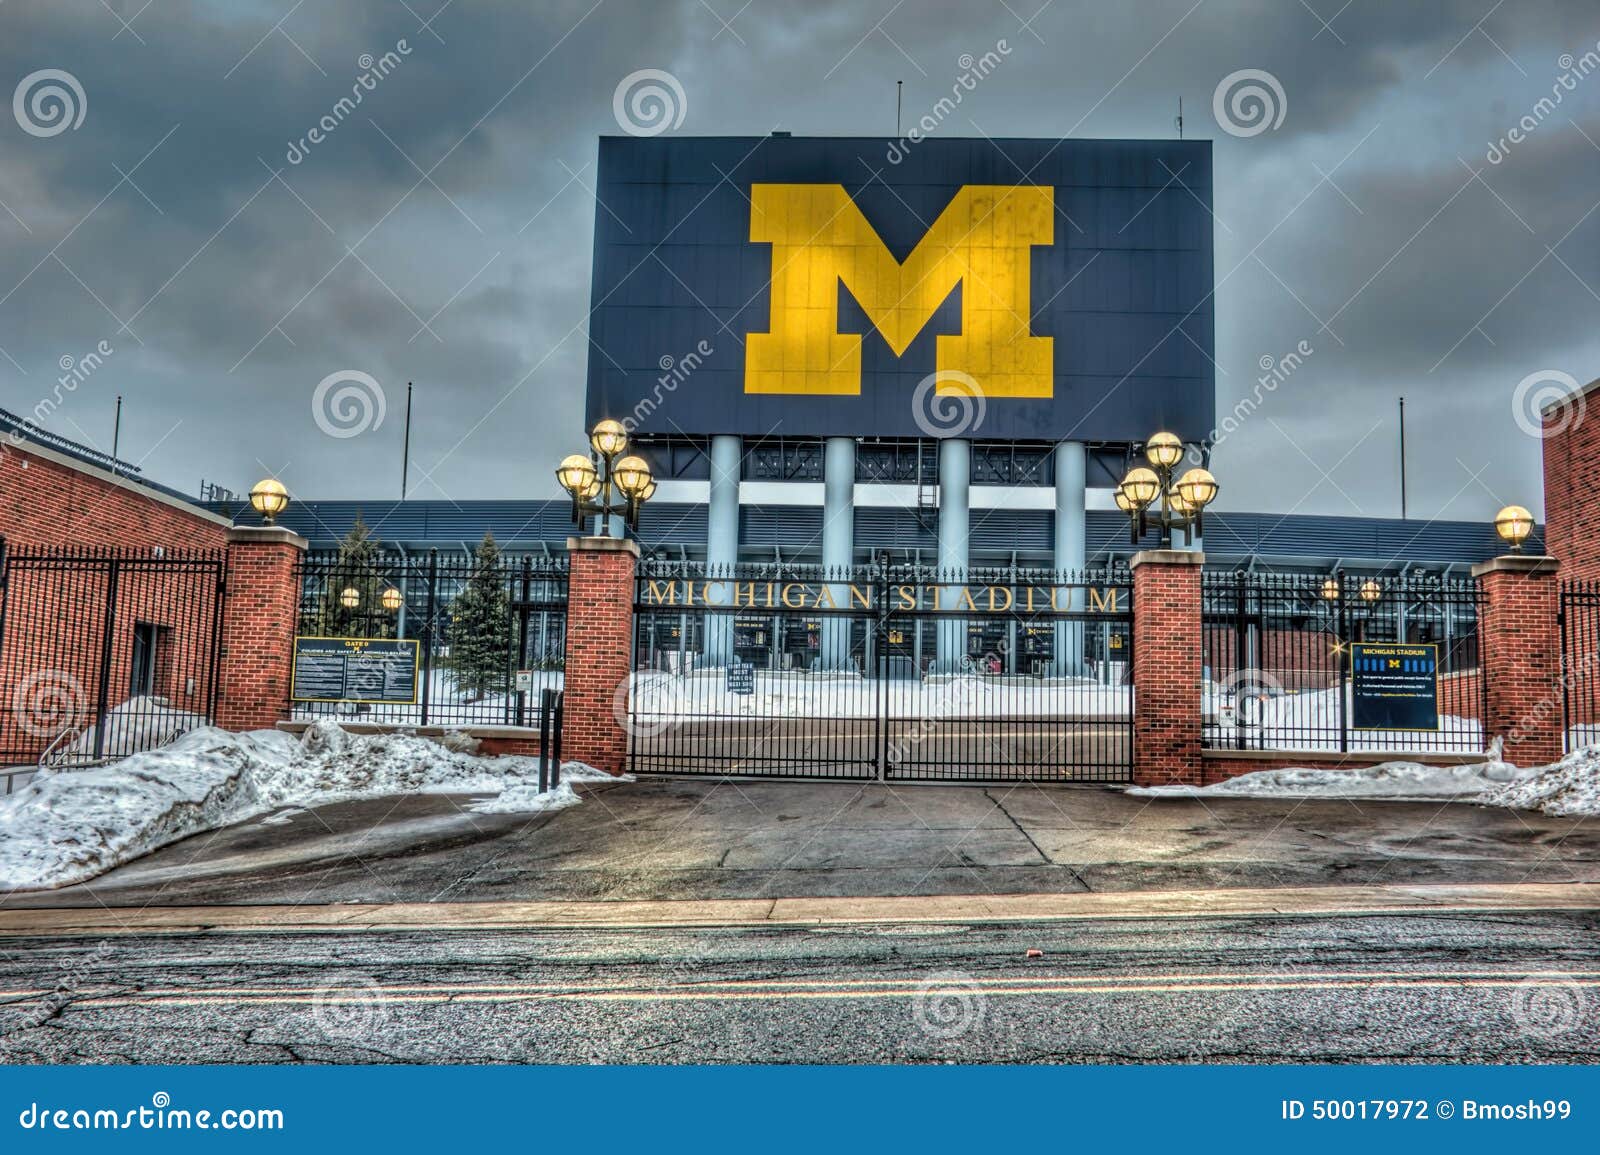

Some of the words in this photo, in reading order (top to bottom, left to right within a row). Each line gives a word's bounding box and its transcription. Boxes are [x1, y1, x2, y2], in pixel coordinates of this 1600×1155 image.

[744, 183, 1055, 399] M
[647, 580, 872, 609] MICHIGAN
[898, 585, 1118, 613] STADIUM
